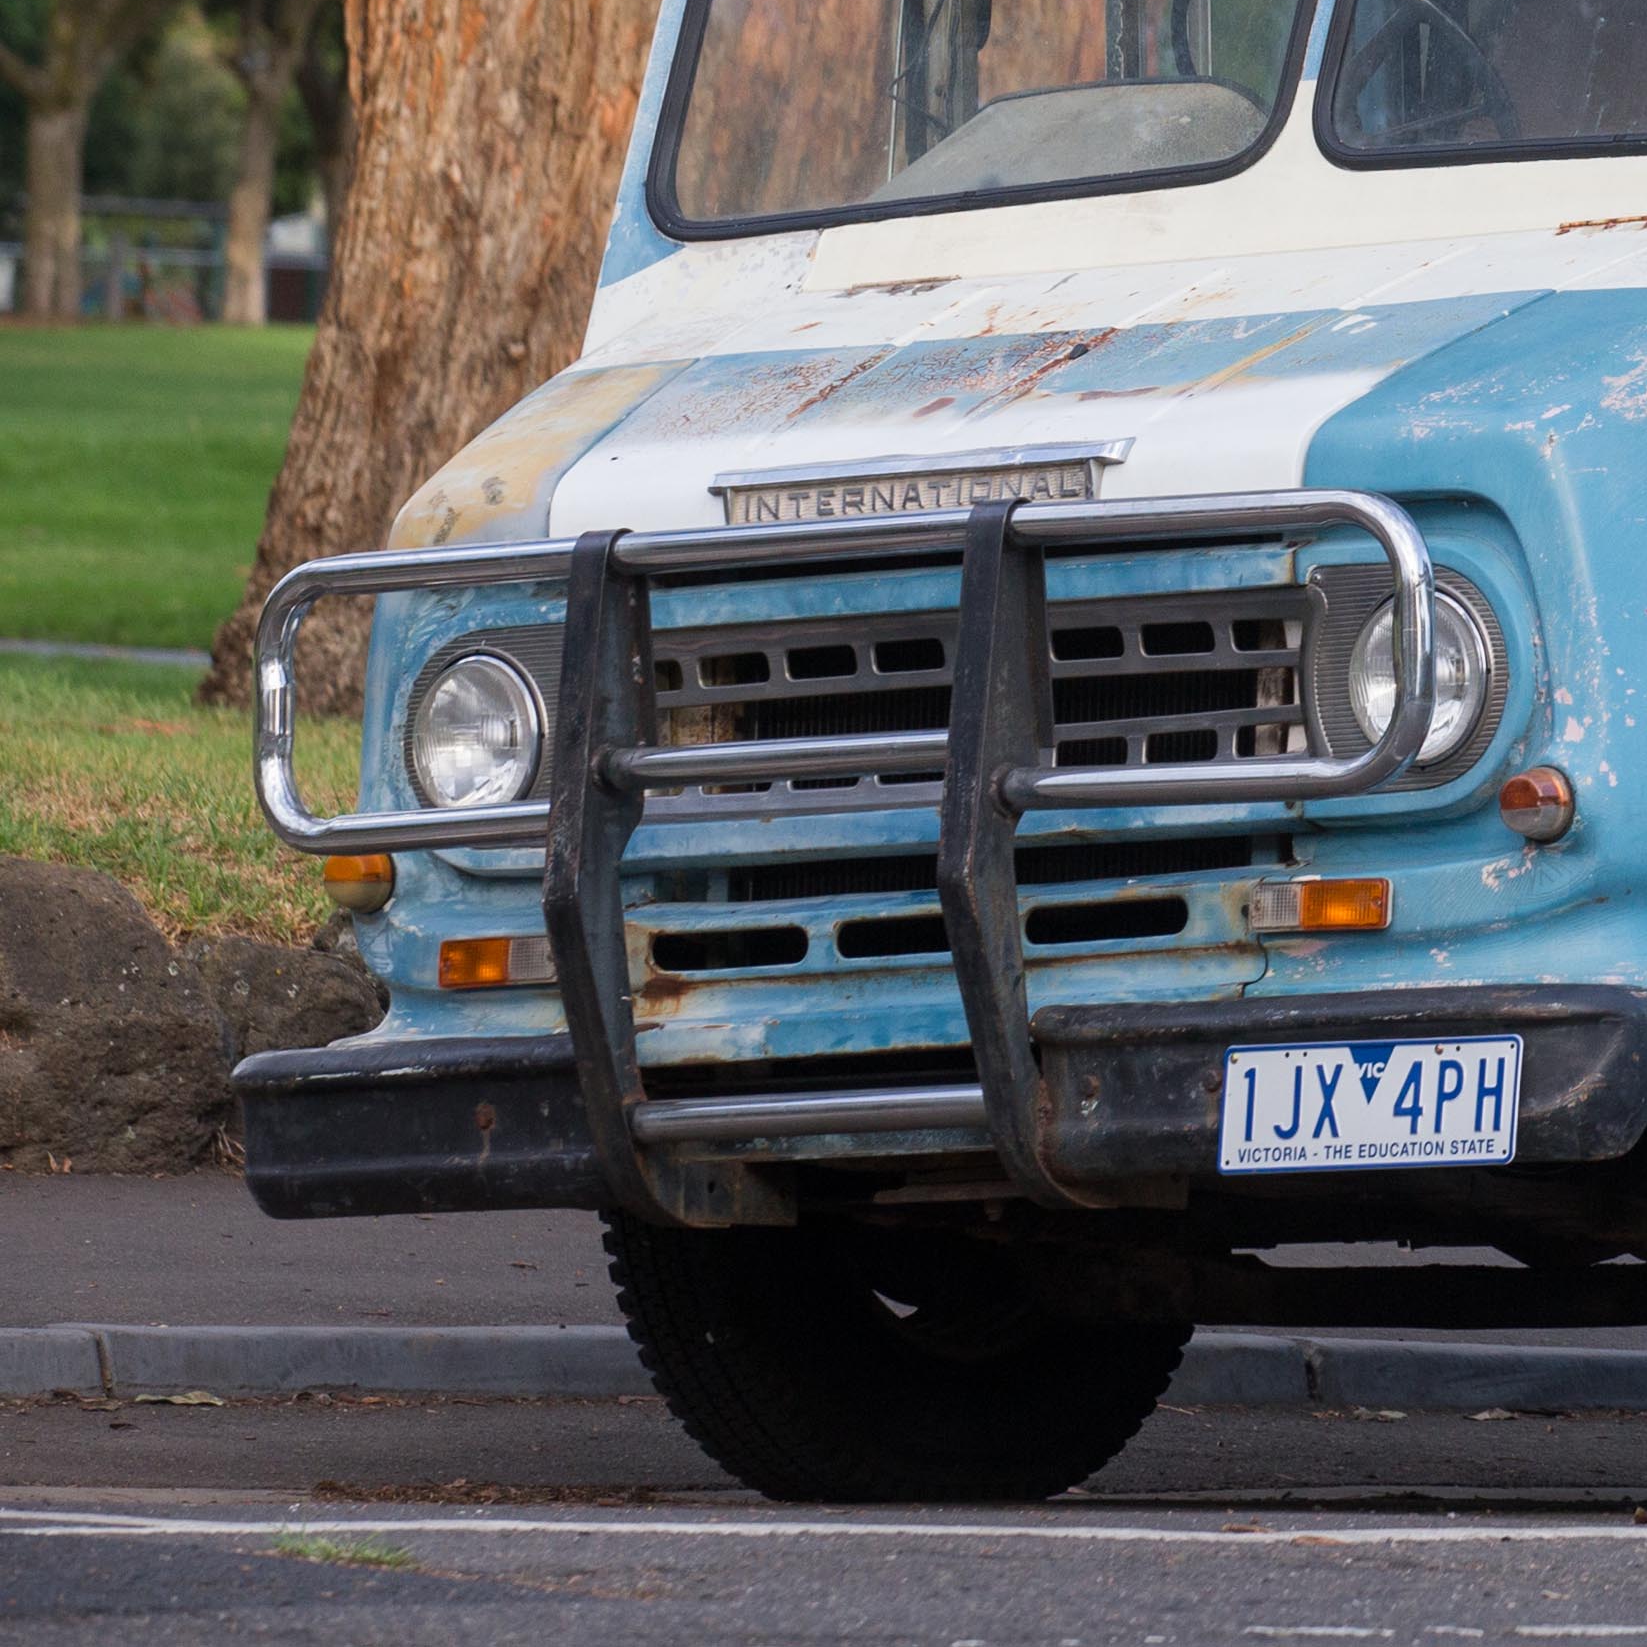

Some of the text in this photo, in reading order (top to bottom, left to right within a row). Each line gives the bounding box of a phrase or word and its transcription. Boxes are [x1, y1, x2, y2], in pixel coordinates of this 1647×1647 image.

[744, 471, 1082, 523] INTERNATIONAL
[1355, 1061, 1386, 1080] VIC
[1243, 1056, 1507, 1143] 1JX 4PH
[1237, 1145, 1307, 1164] VICTORIA
[1324, 1144, 1353, 1160] THE
[1357, 1141, 1445, 1160] EDUCATION
[1449, 1138, 1496, 1155] STATE
